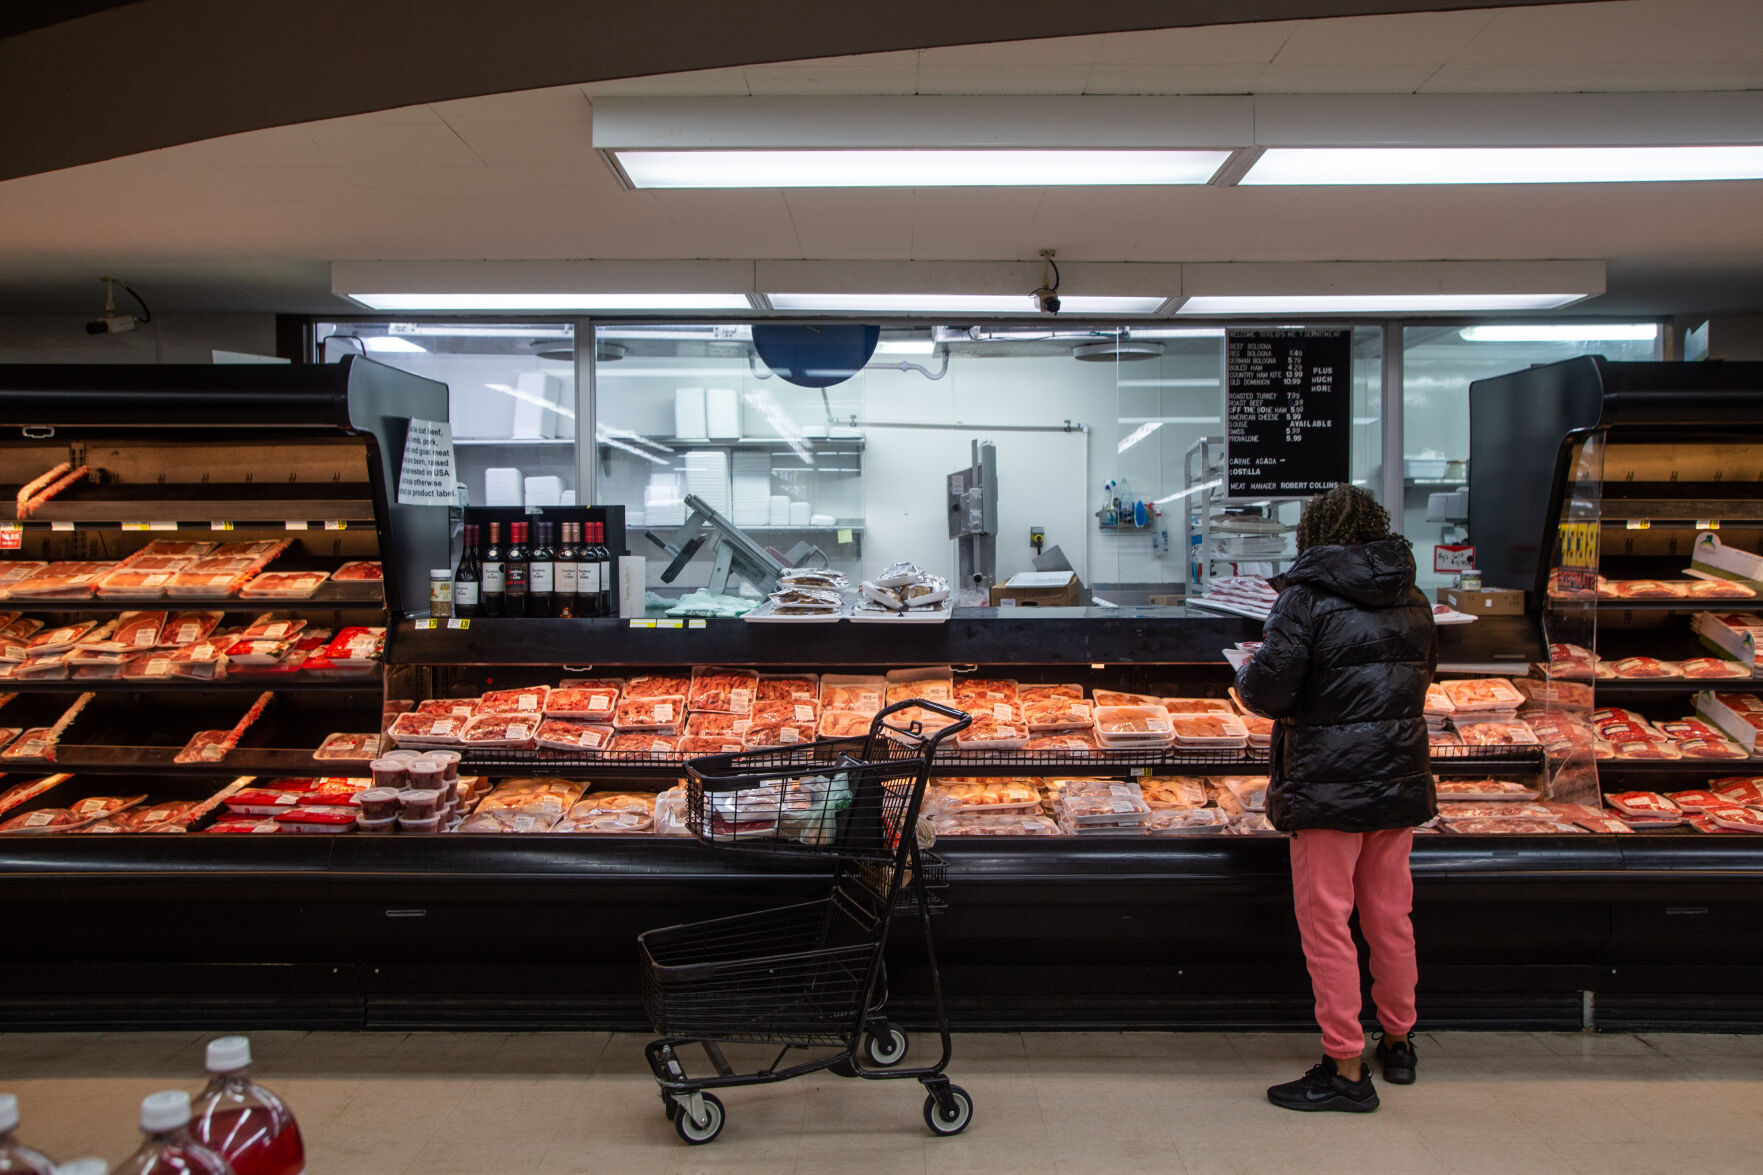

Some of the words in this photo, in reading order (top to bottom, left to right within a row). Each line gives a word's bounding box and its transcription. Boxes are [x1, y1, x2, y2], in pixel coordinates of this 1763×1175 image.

[1244, 406, 1255, 414] THE
[1256, 406, 1273, 414] BONE
[1289, 420, 1332, 428] AVAILABLE
[1285, 435, 1302, 443] 5.99
[1229, 457, 1251, 465] CARNE
[1255, 457, 1277, 465] ASADA
[433, 469, 450, 477] USA
[1230, 468, 1261, 476] COSTILLA
[1280, 481, 1307, 489] ROBERT
[1309, 481, 1339, 489] COLLINS
[412, 489, 434, 498] product
